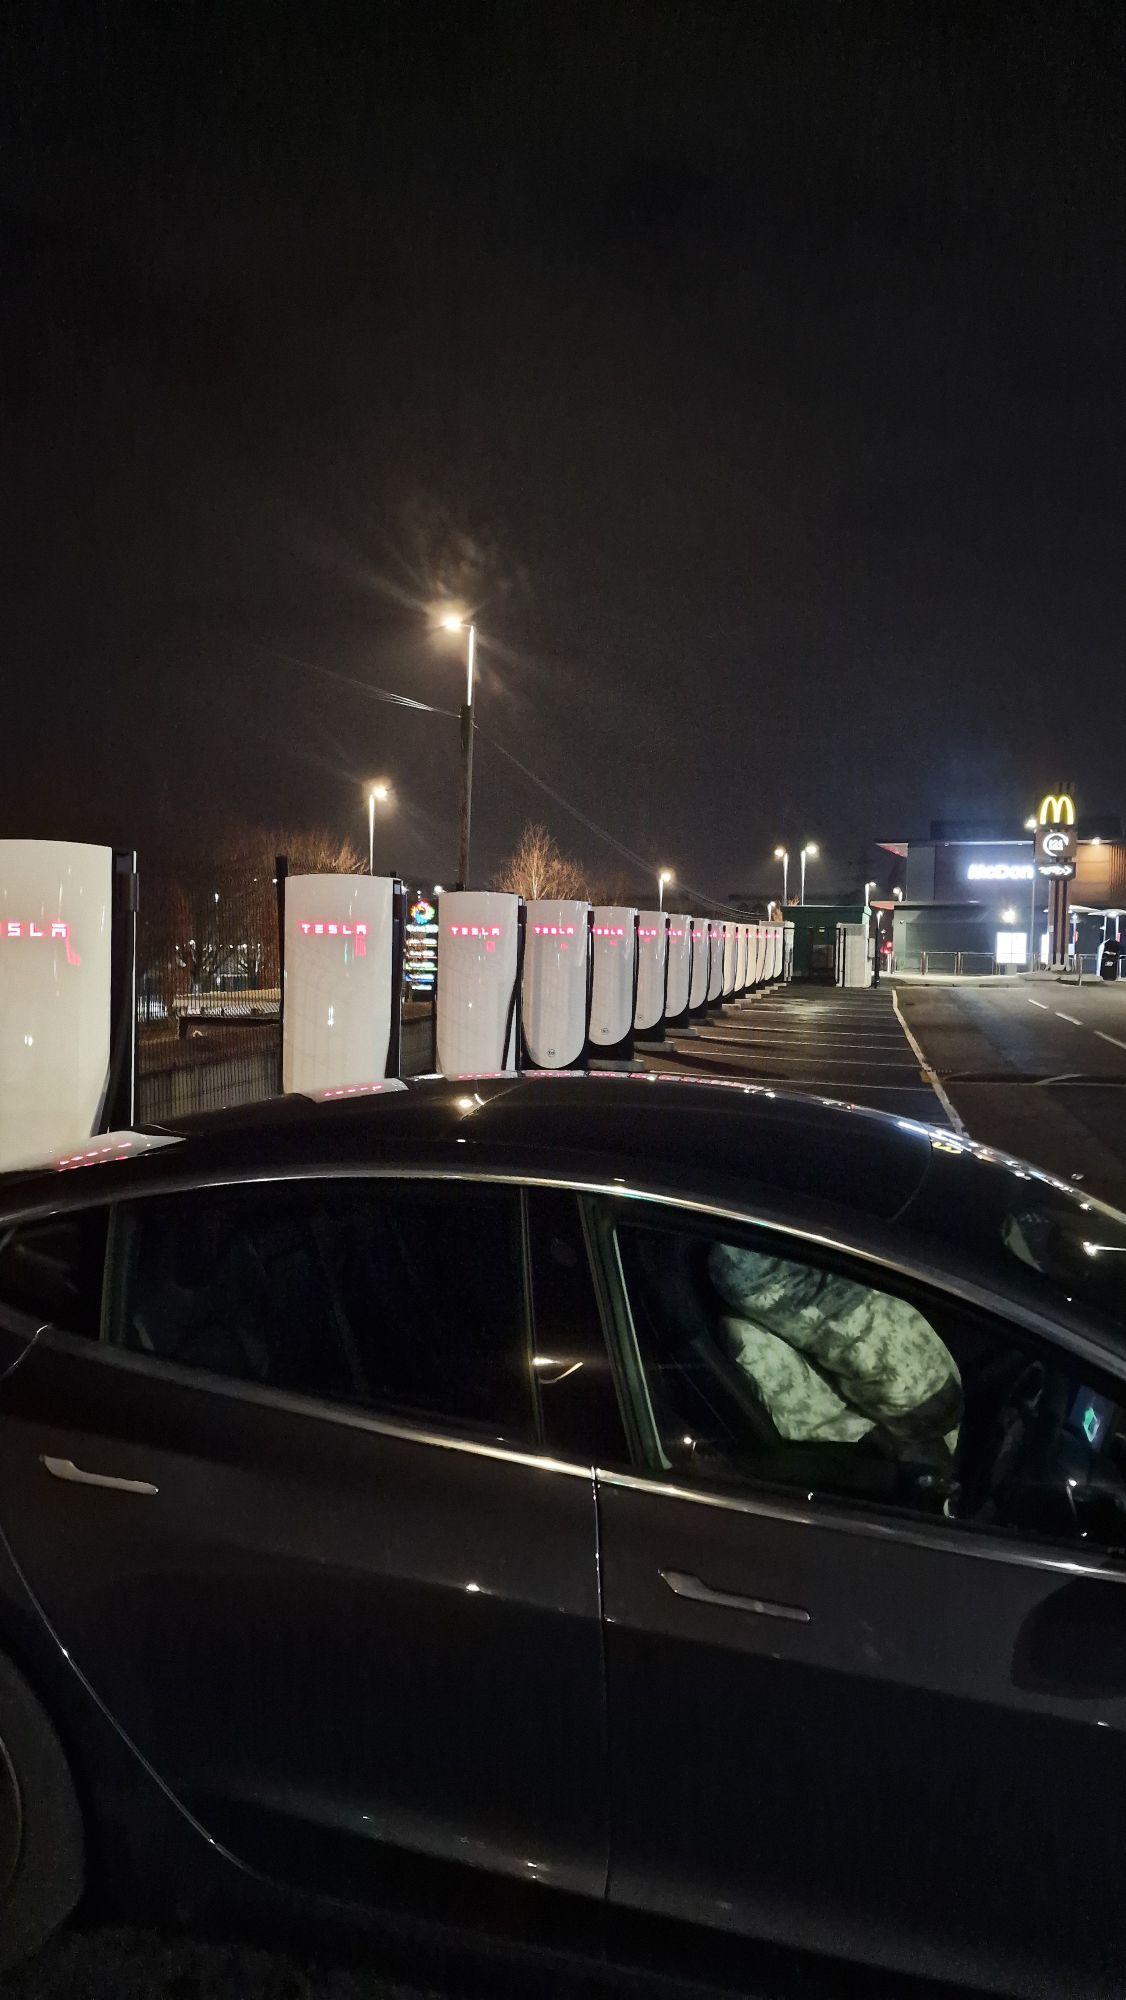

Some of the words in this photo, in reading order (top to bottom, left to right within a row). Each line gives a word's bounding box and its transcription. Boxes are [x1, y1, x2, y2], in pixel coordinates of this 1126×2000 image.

[302, 924, 367, 934] TESLA
[451, 927, 500, 936] TESLA
[535, 927, 574, 935] TESLA
